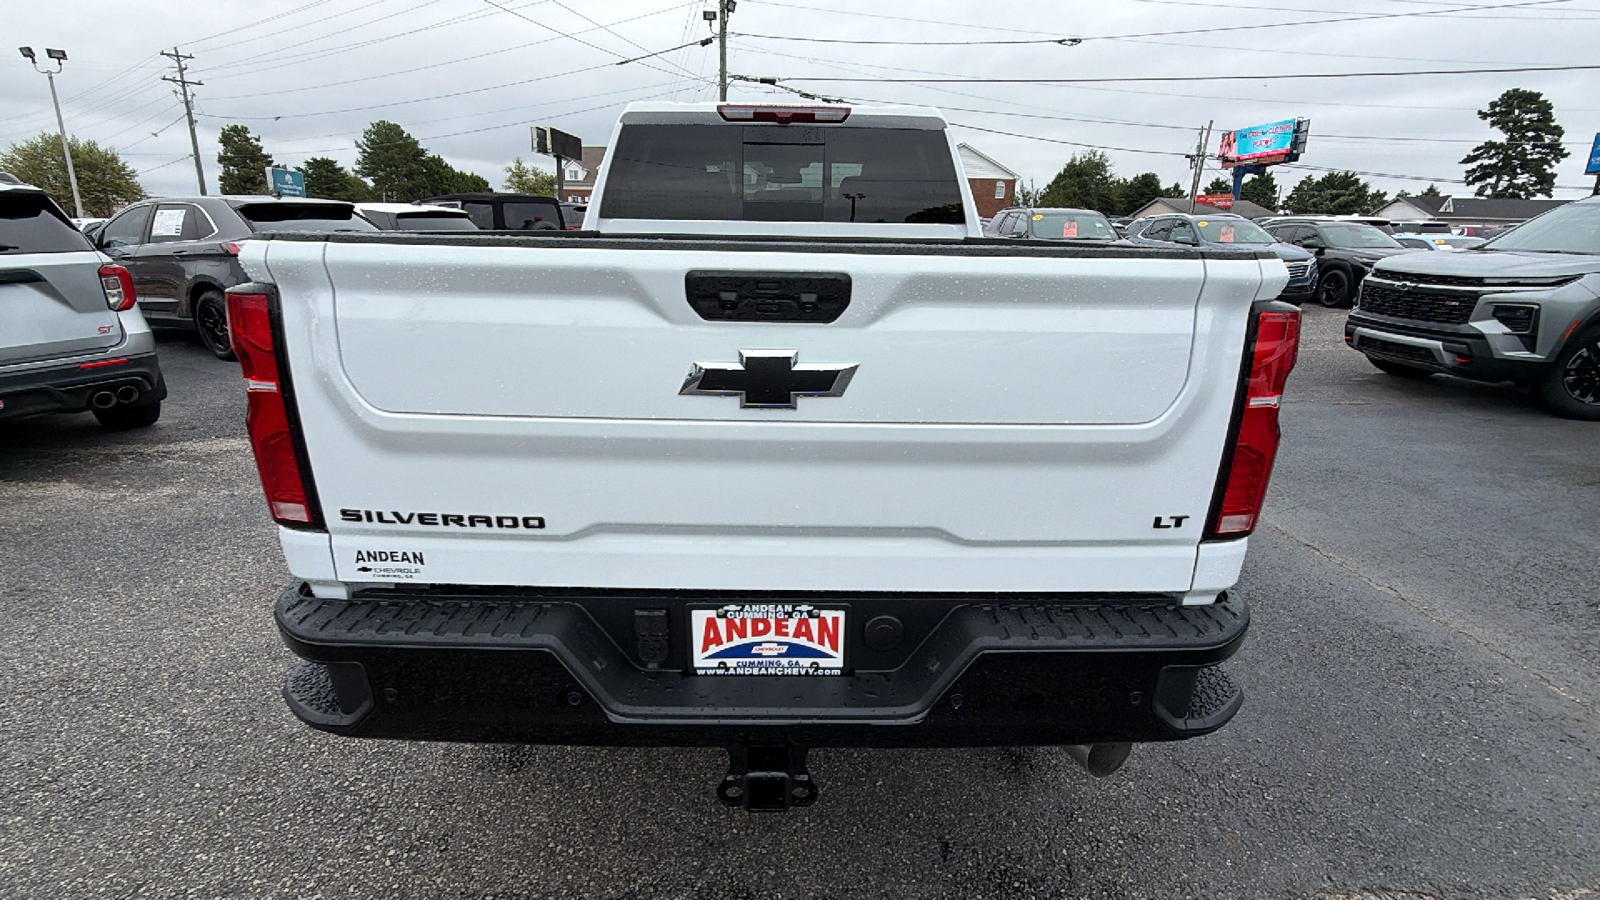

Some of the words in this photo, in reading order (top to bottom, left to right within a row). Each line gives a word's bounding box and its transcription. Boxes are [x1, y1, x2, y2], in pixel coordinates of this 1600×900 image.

[339, 508, 546, 530] SILVERADO
[1152, 514, 1191, 529] LT
[354, 549, 426, 566] ANDEAN
[743, 604, 793, 612] ANDEAN
[701, 616, 840, 654] ANDEAN
[735, 659, 786, 668] CUMMING,
[696, 667, 842, 676] www.ANDEANCHEVY.com
